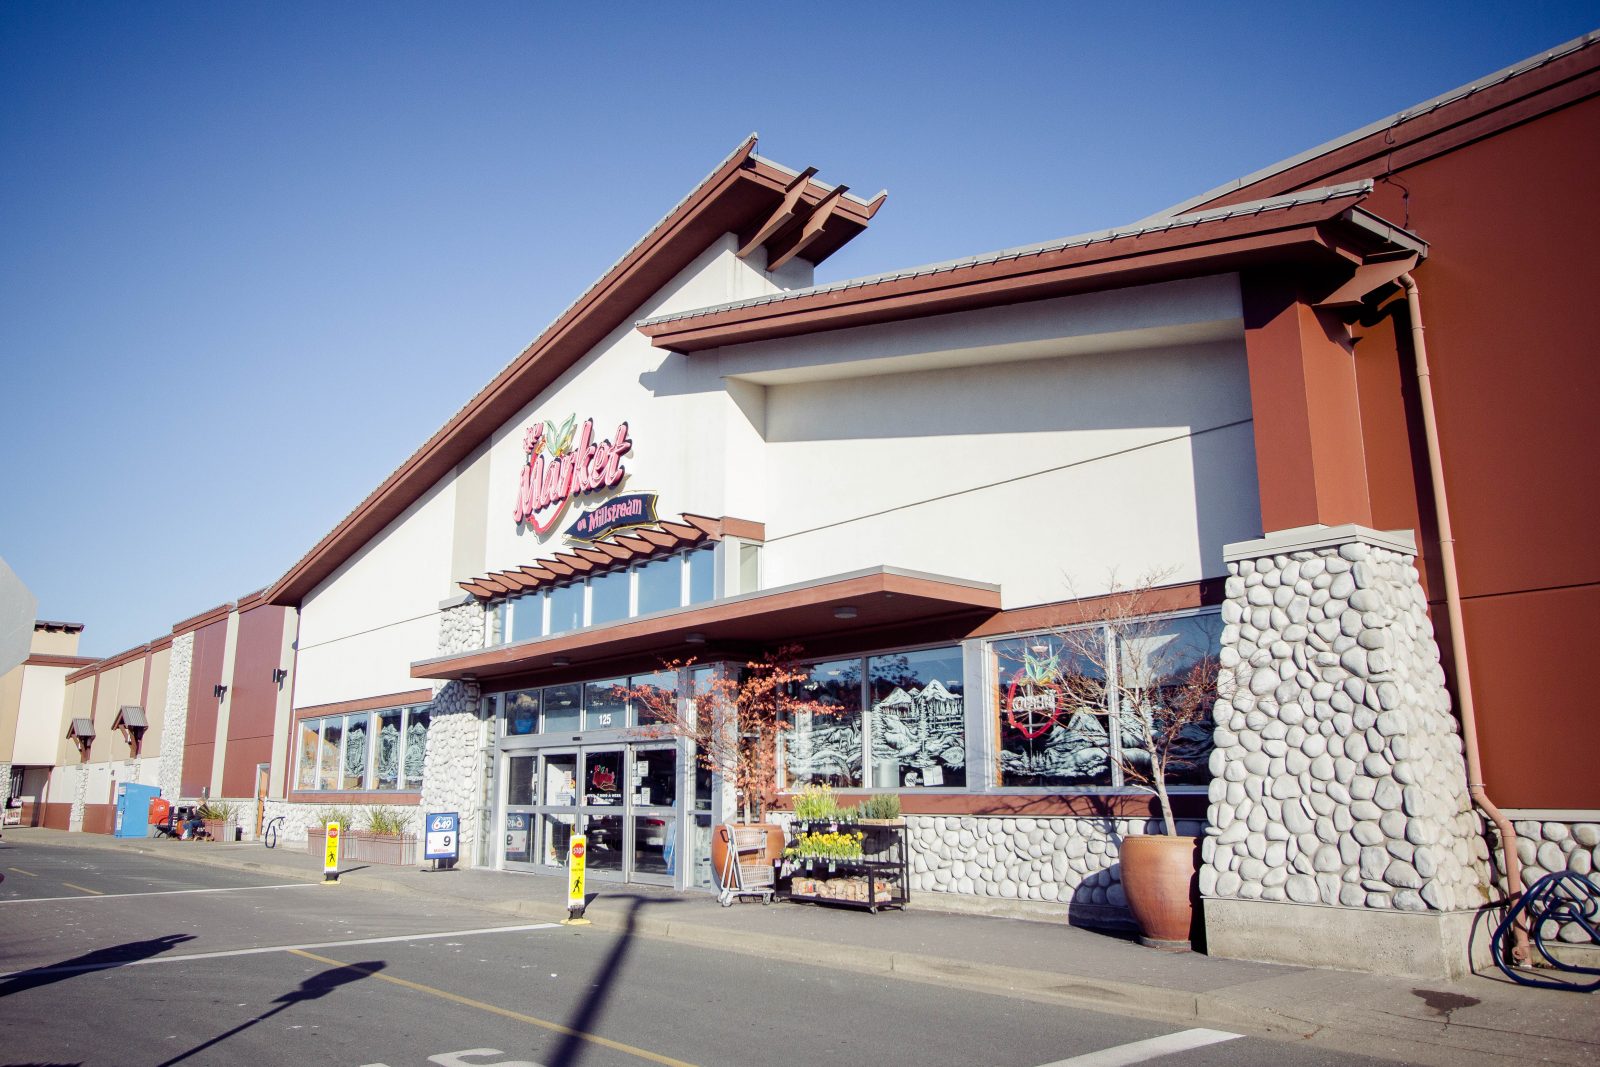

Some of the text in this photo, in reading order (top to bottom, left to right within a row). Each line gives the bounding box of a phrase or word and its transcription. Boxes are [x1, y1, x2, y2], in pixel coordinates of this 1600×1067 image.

[513, 417, 633, 523] Market
[588, 499, 642, 532] Millstream
[598, 714, 611, 725] 125
[443, 836, 451, 846] 9
[572, 846, 585, 854] STOP
